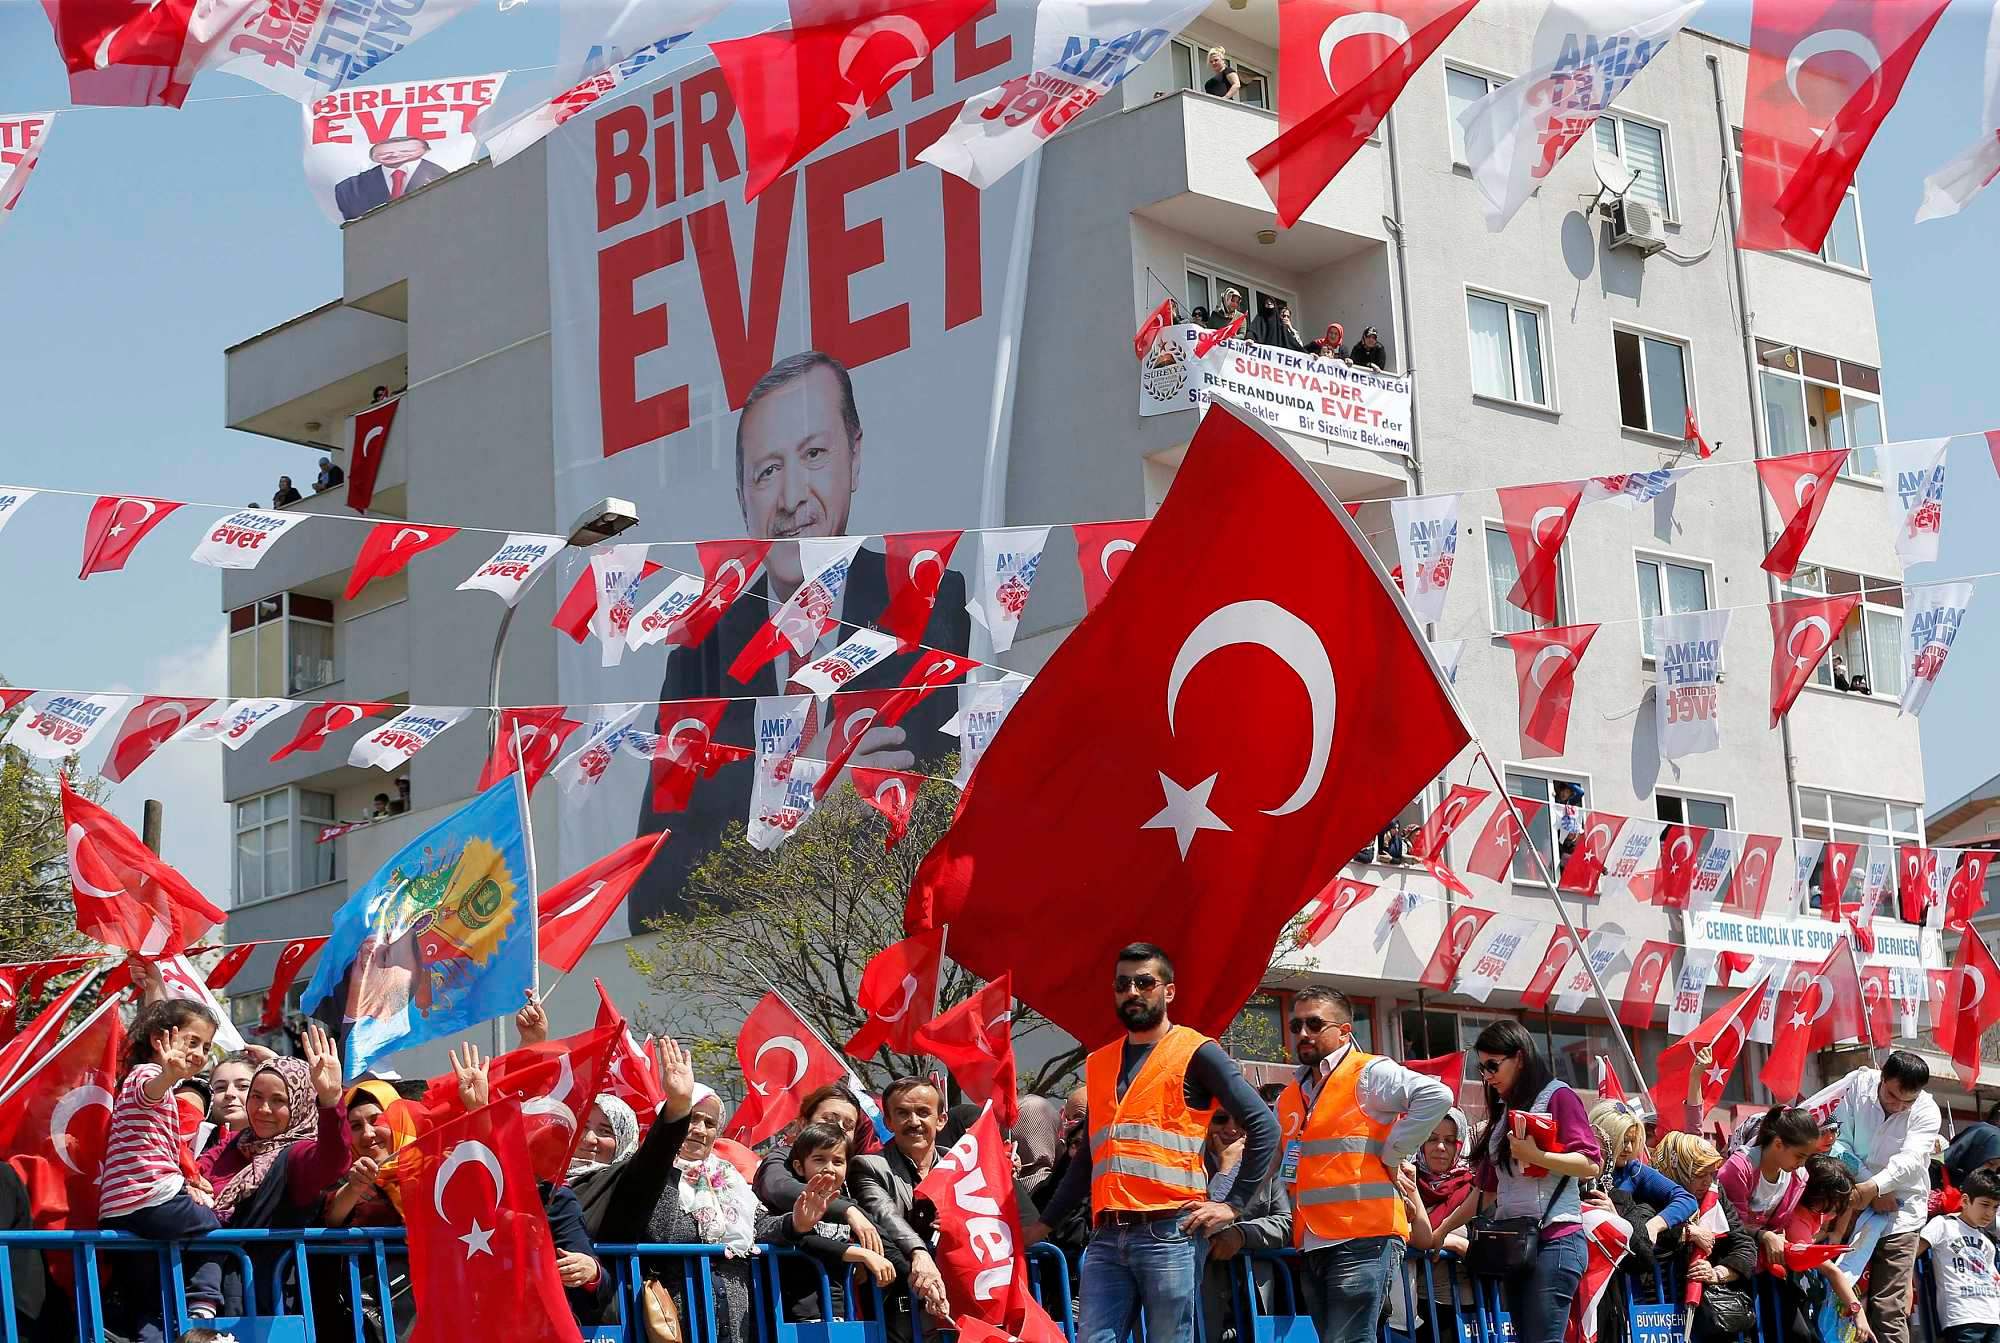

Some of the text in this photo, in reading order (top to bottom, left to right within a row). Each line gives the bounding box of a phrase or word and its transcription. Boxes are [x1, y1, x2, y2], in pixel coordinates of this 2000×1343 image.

[312, 103, 489, 145] EVET
[597, 100, 983, 459] EVET
[1235, 357, 1364, 403] SÜREYYA-DER
[1277, 352, 1302, 369] TEK
[1306, 359, 1348, 381] KADIN
[1204, 372, 1315, 412] REFERANDUMDA
[211, 528, 268, 549] evet
[1706, 921, 1743, 943] CEMRE
[1746, 923, 1790, 948] GENÇLİK
[1791, 928, 1804, 947] VE
[1807, 931, 1833, 950] SPOR
